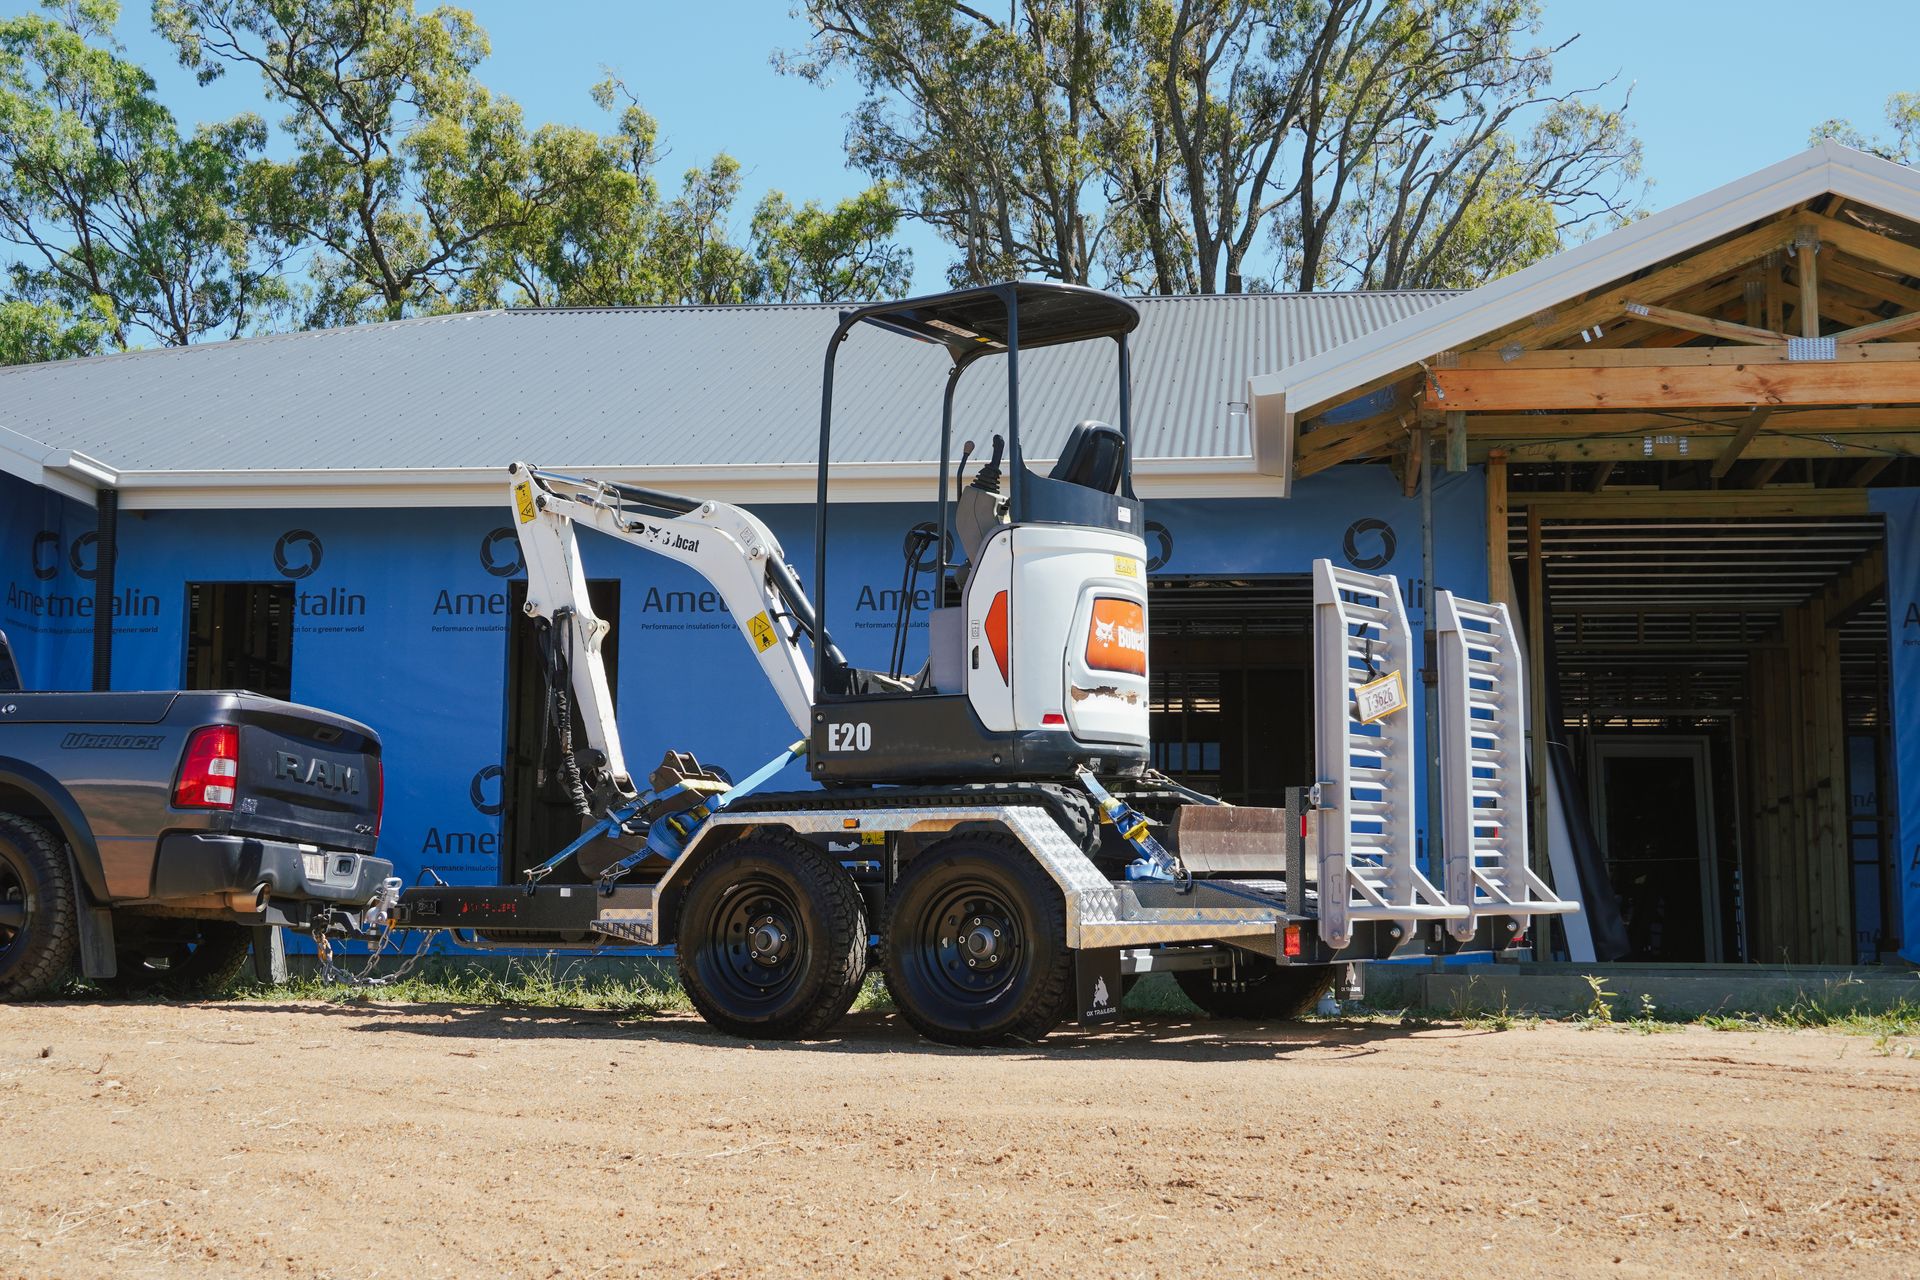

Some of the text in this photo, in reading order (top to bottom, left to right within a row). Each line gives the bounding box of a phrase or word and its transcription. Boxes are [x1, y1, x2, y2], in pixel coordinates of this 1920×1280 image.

[662, 531, 700, 553] bcat
[294, 587, 366, 616] talin
[302, 625, 312, 633] for
[318, 626, 343, 635] greener
[345, 625, 365, 633] world
[432, 625, 475, 633] Performance
[641, 623, 684, 631] Performance
[686, 622, 719, 630] insulation
[720, 622, 732, 630] for
[60, 732, 167, 751] WARLOCK
[828, 722, 872, 752] E20
[275, 750, 361, 795] RAM
